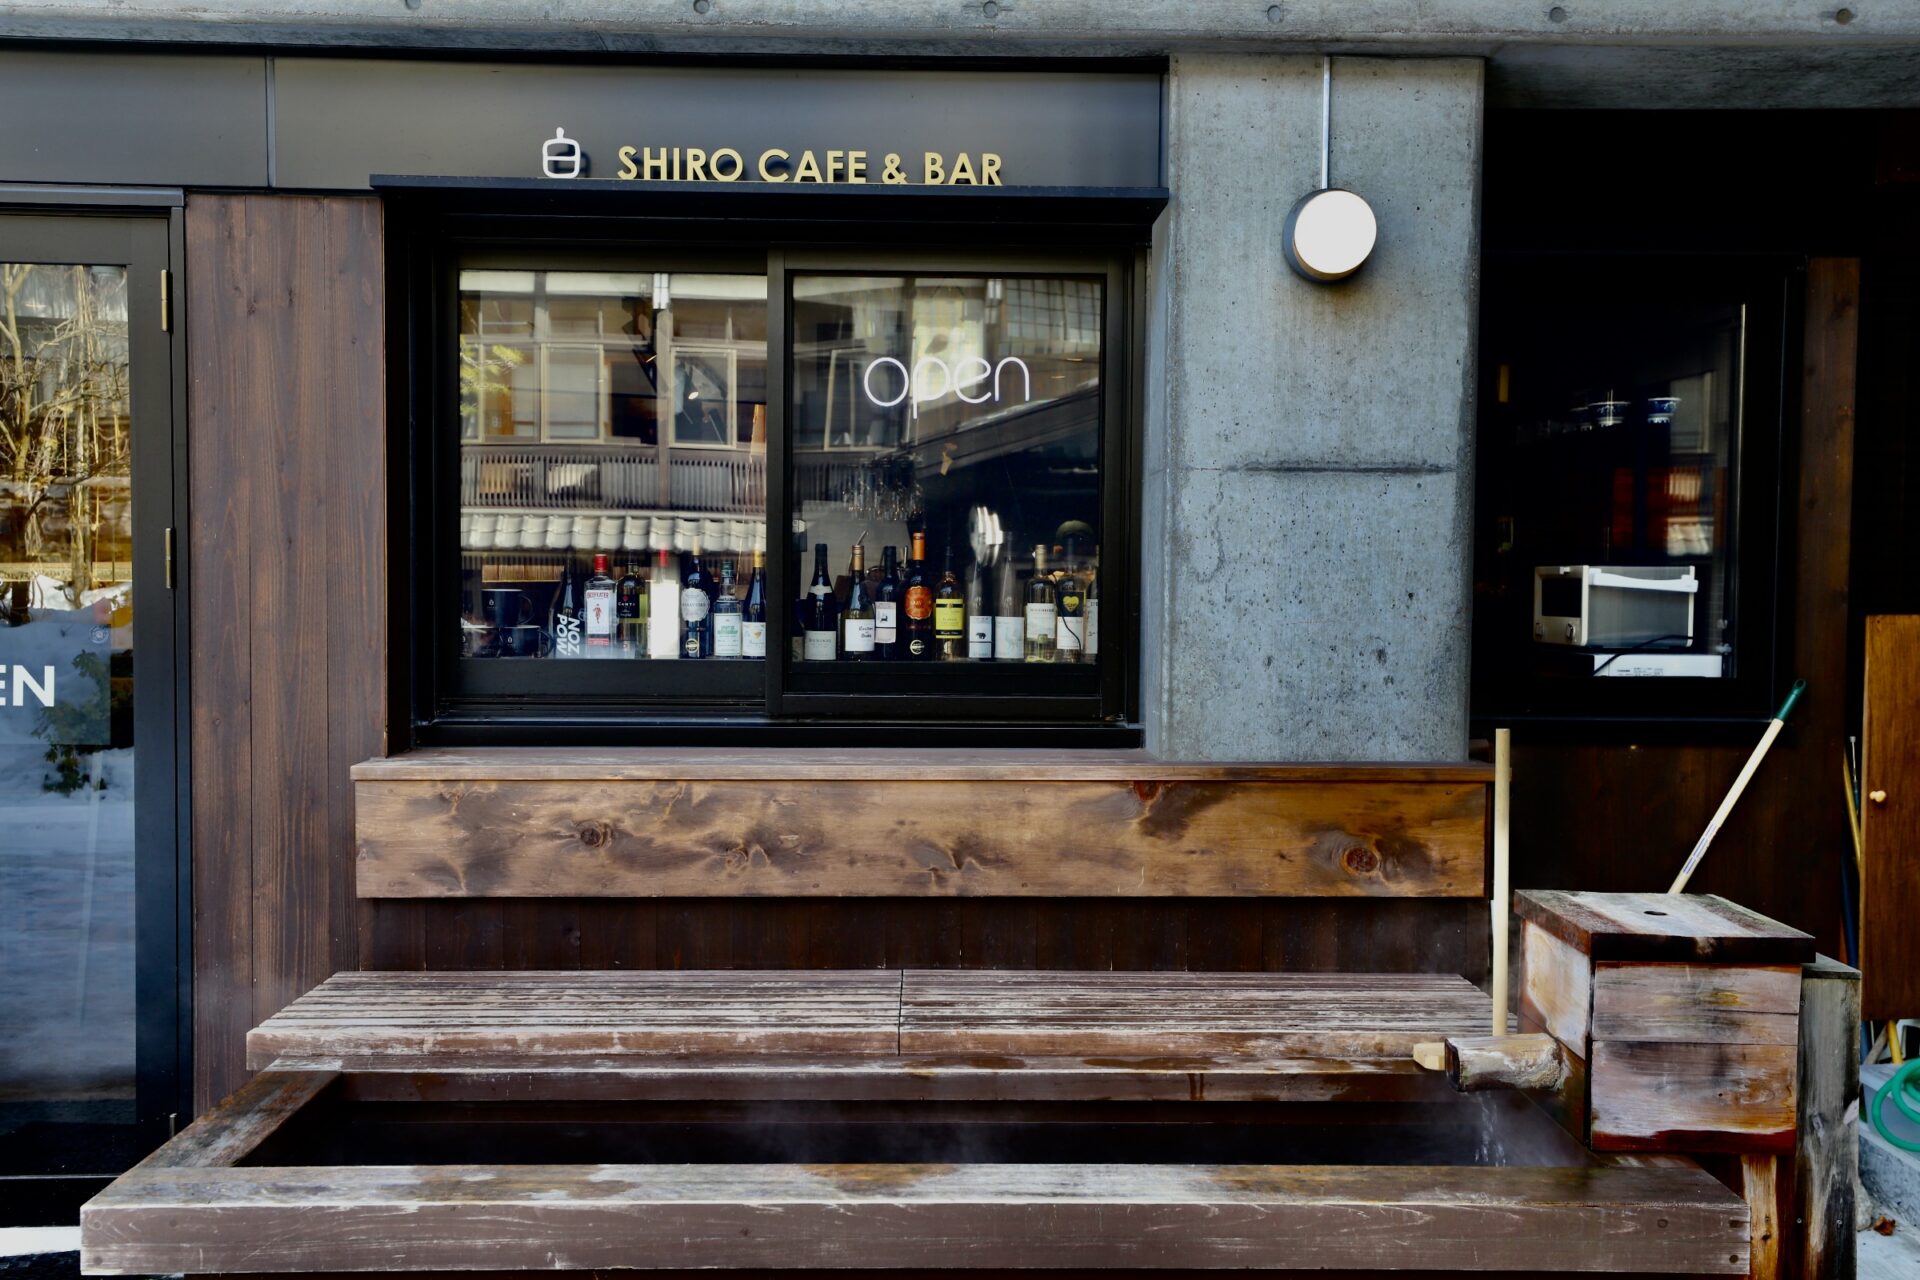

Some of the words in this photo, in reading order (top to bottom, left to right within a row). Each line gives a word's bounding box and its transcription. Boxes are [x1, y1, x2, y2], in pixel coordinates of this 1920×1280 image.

[617, 145, 744, 182] SHIRO
[758, 148, 867, 184] CAFE
[881, 153, 908, 184] &
[924, 151, 1003, 186] BAR
[864, 356, 1030, 419] open
[0, 664, 55, 707] N
